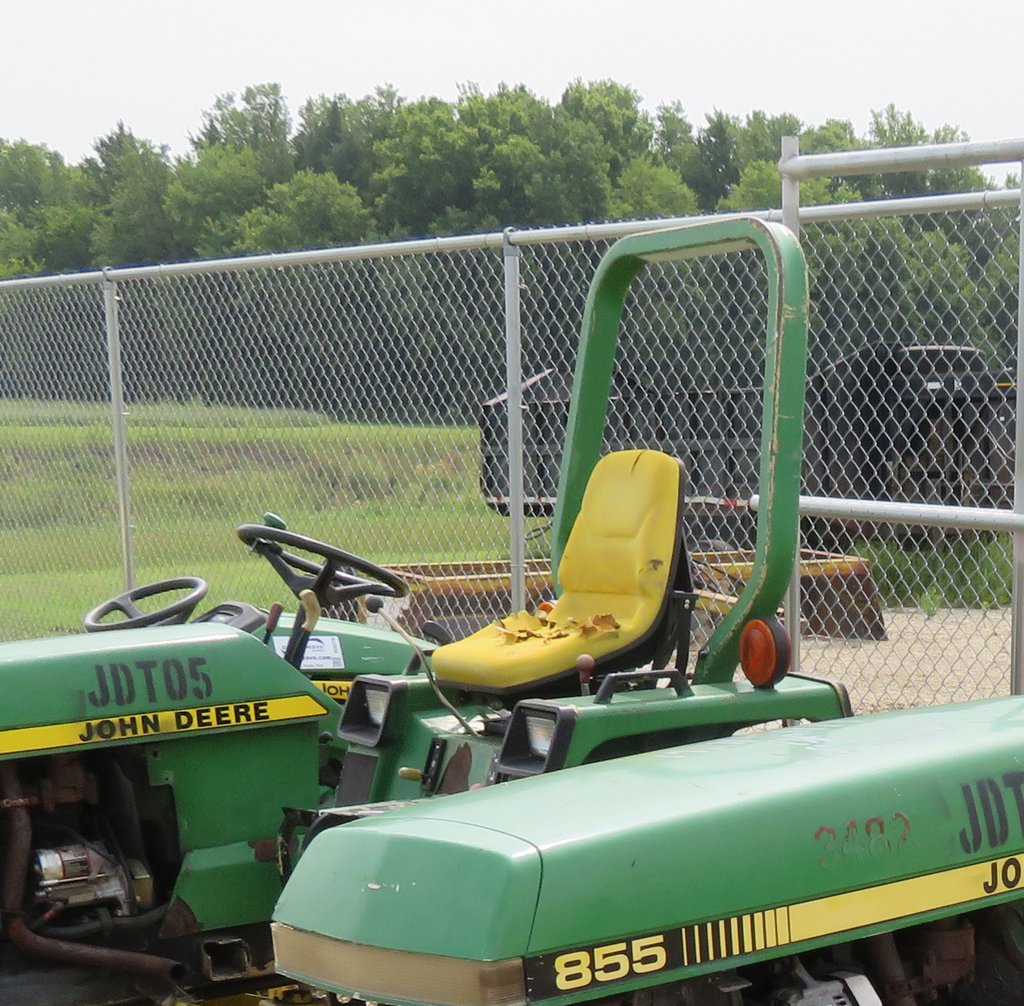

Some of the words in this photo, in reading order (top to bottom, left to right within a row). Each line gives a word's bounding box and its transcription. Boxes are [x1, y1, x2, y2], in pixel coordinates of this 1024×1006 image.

[88, 657, 213, 707] JDT05
[322, 683, 350, 695] JOH
[79, 714, 161, 742] JOHN
[175, 702, 269, 730] DEERE
[554, 934, 667, 991] 855
